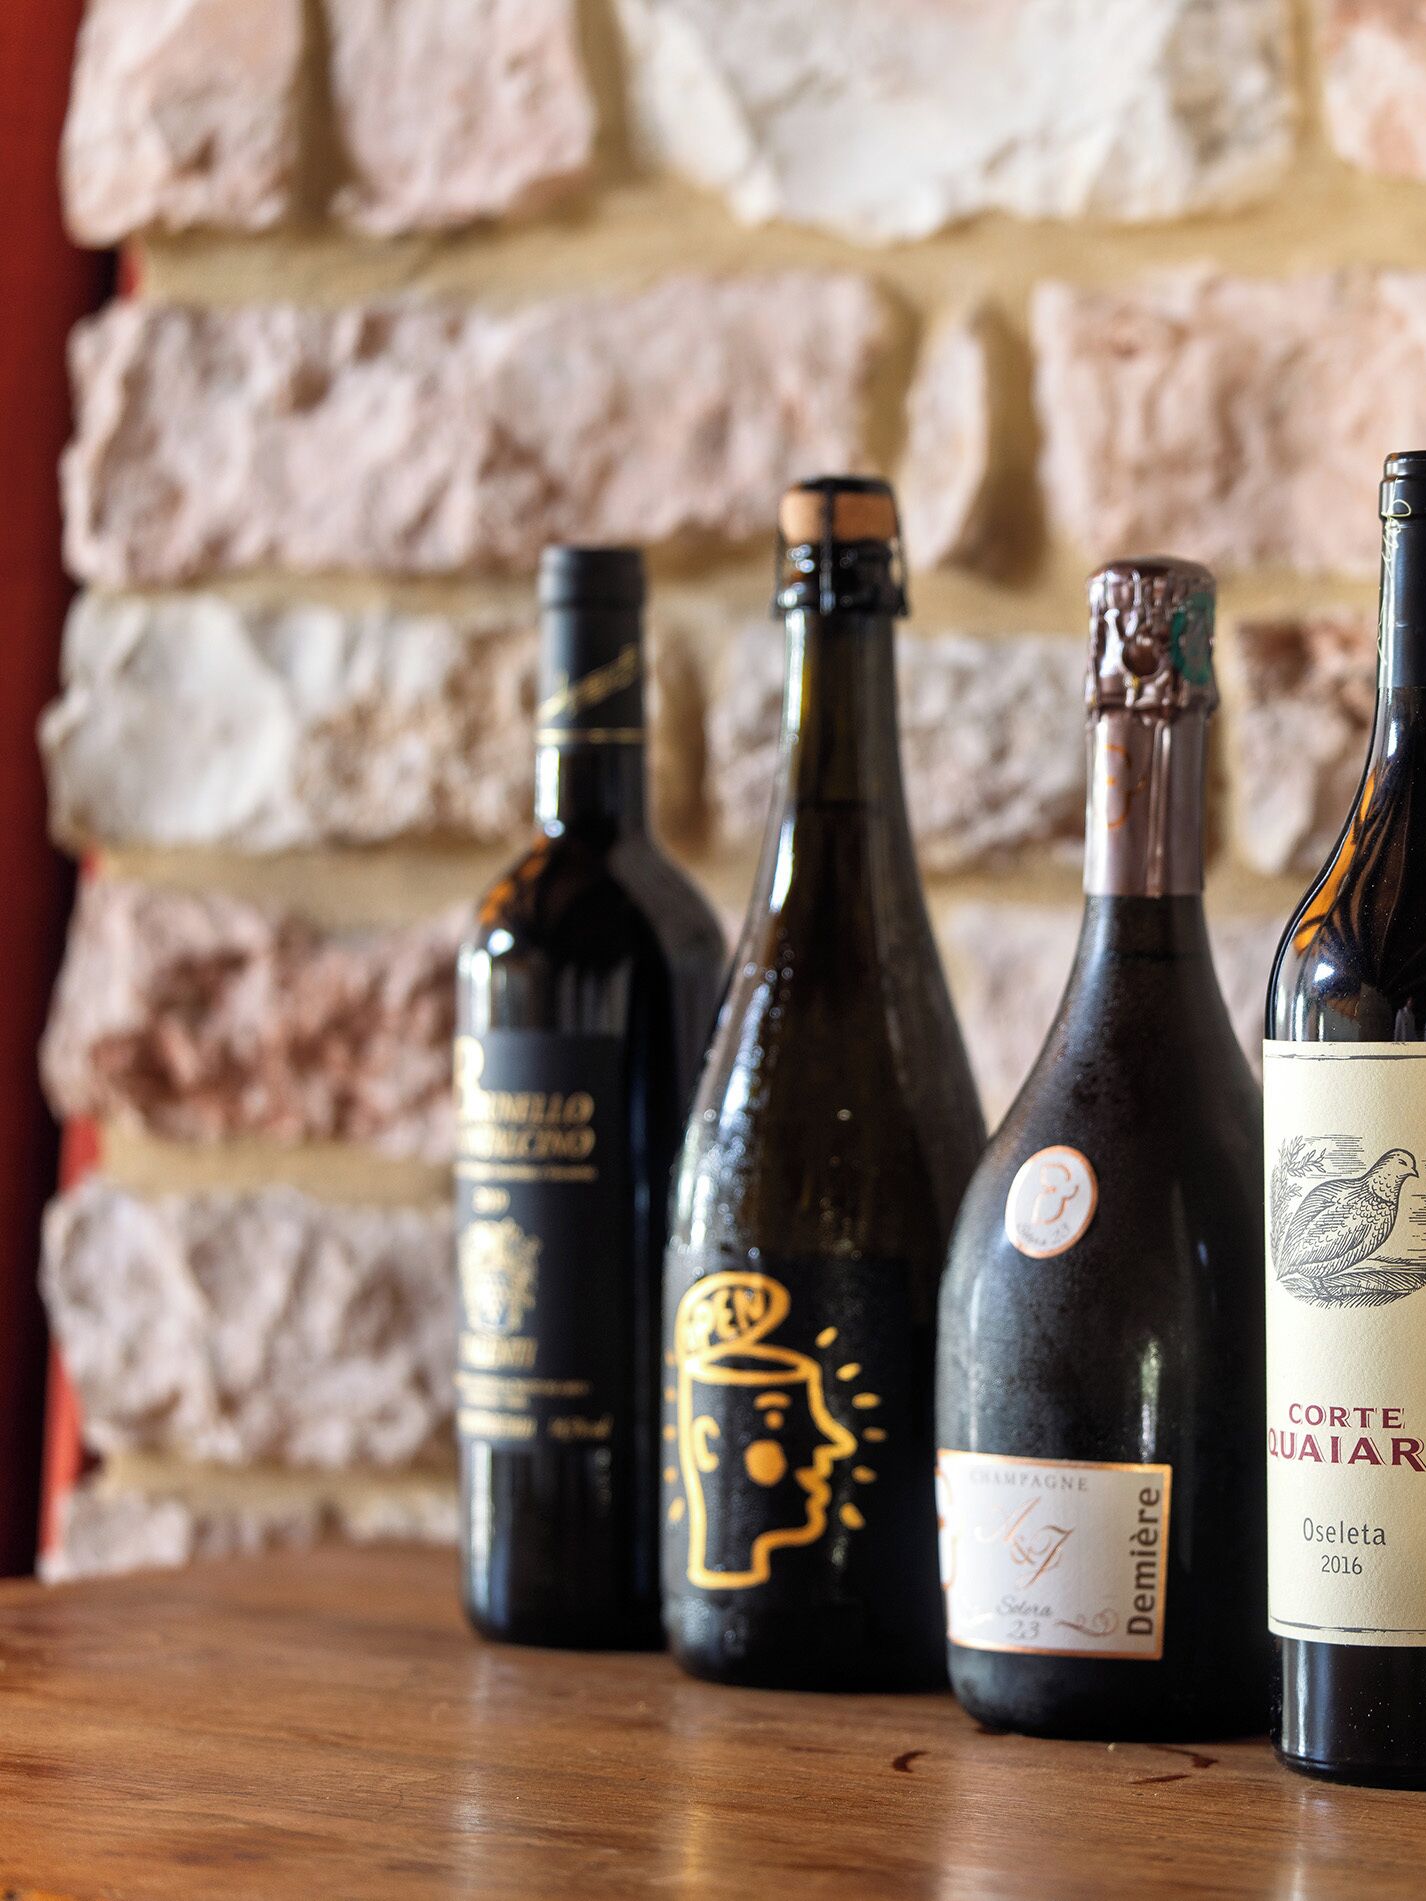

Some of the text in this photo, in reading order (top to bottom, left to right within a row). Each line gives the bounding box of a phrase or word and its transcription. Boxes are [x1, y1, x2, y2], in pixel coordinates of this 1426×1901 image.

[1288, 1402, 1406, 1430] CORTE
[969, 1470, 1089, 1492] CHAMPAGNE
[1303, 1516, 1387, 1546] Oseleta
[1125, 1486, 1160, 1637] Demière
[1320, 1554, 1363, 1575] 2016
[1006, 1618, 1040, 1640] 23
